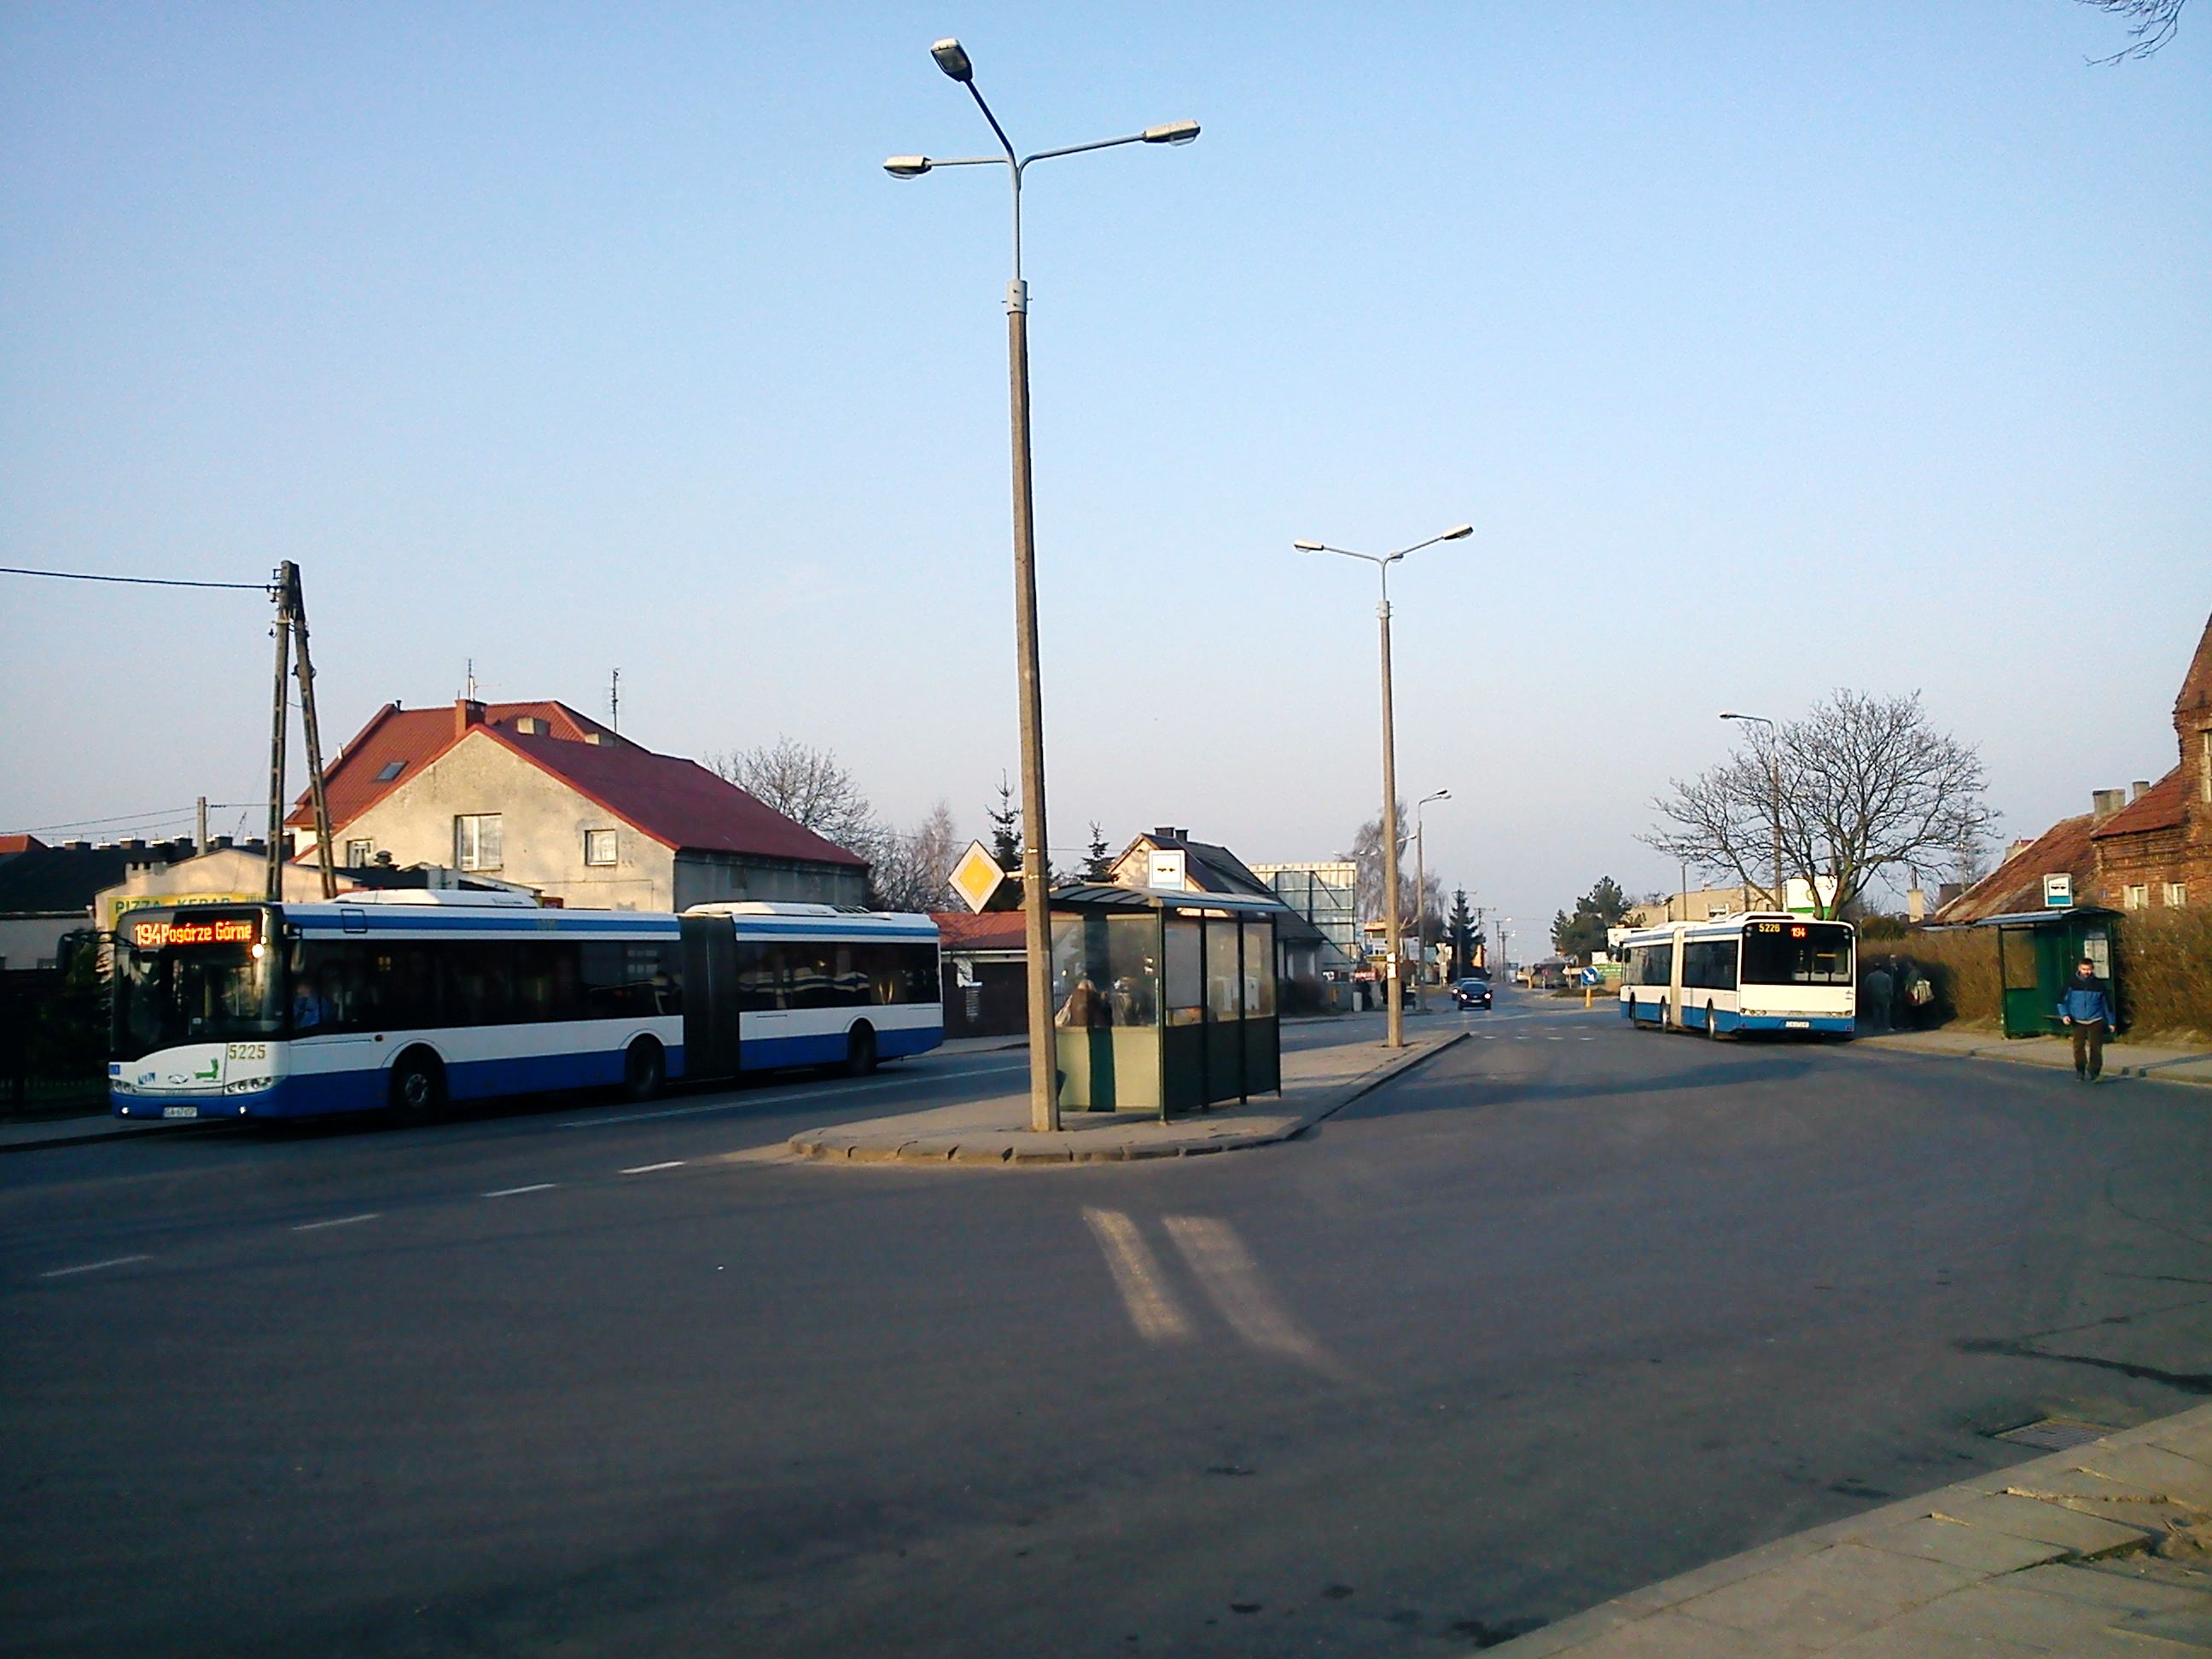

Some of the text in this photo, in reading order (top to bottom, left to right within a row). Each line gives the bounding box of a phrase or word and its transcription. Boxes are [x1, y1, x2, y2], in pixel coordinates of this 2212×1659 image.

[135, 922, 252, 945] 194 Pogórze Górne
[1791, 928, 1806, 937] 194
[229, 1044, 265, 1060] 5225
